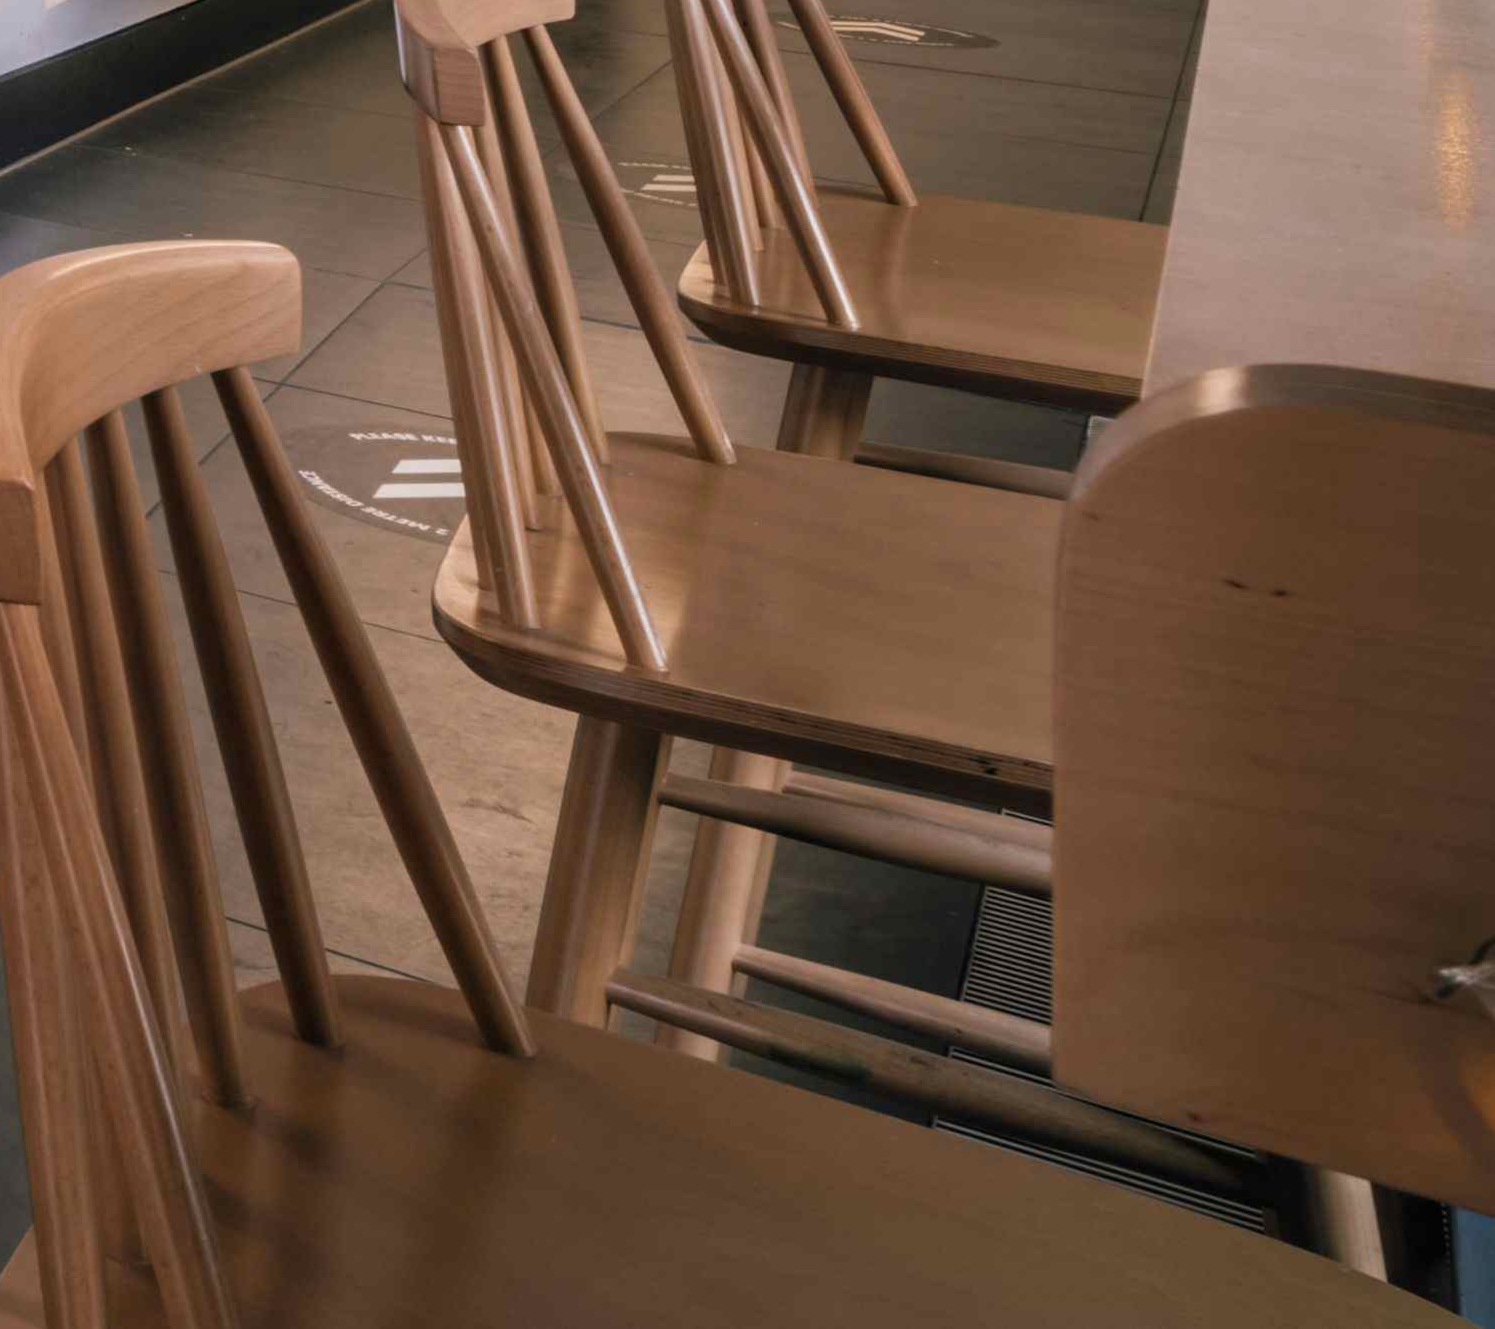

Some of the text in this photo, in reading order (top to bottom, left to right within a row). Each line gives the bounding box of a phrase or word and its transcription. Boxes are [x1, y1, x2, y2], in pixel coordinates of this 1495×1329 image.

[348, 432, 459, 445] PLEASE KEE
[298, 470, 364, 508] DISTANCE
[362, 506, 431, 531] METRE
